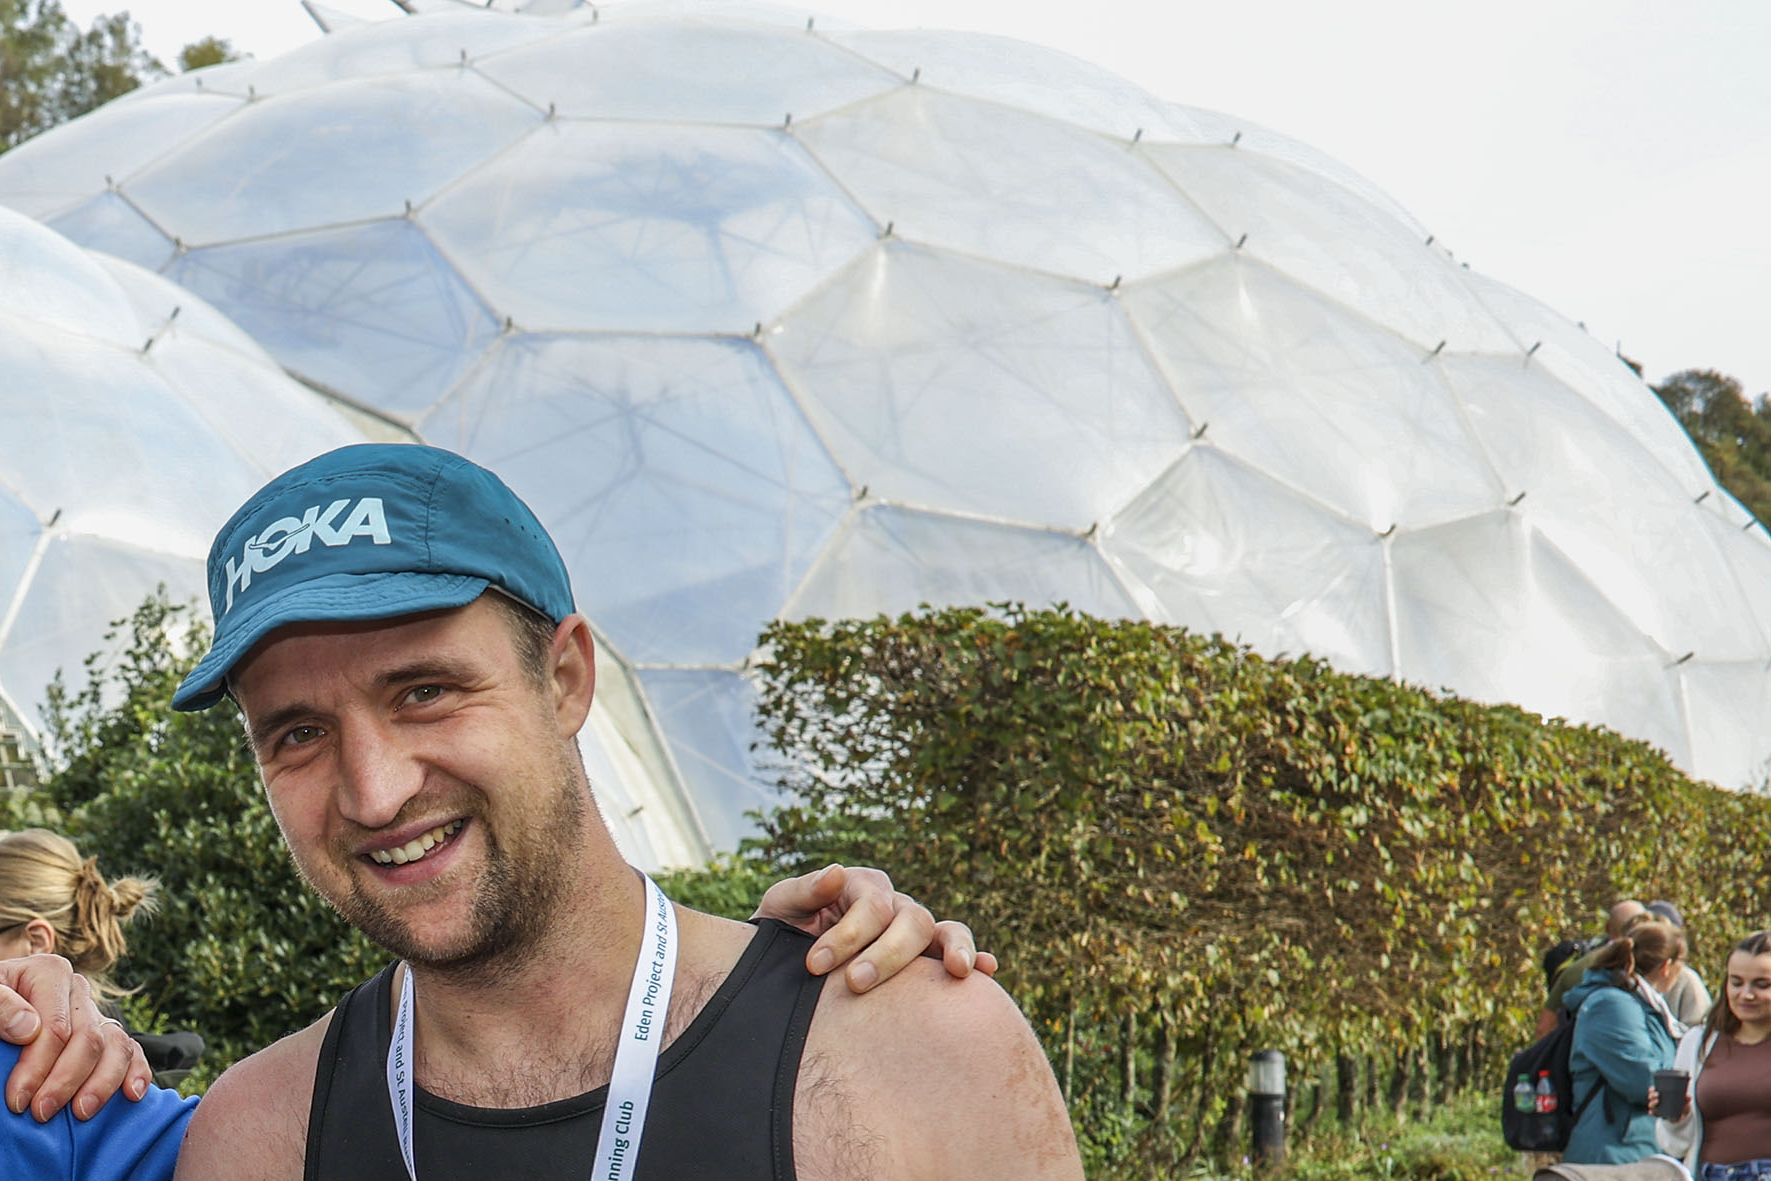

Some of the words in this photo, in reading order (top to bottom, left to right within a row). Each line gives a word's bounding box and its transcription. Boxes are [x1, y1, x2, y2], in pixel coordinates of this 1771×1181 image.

[225, 497, 392, 615] HOKA
[656, 921, 668, 935] St
[655, 934, 668, 960] and
[642, 960, 664, 1007] Project
[634, 1010, 653, 1041] Eden
[395, 1044, 405, 1069] and
[396, 1070, 406, 1087] St
[615, 1100, 634, 1135] Club
